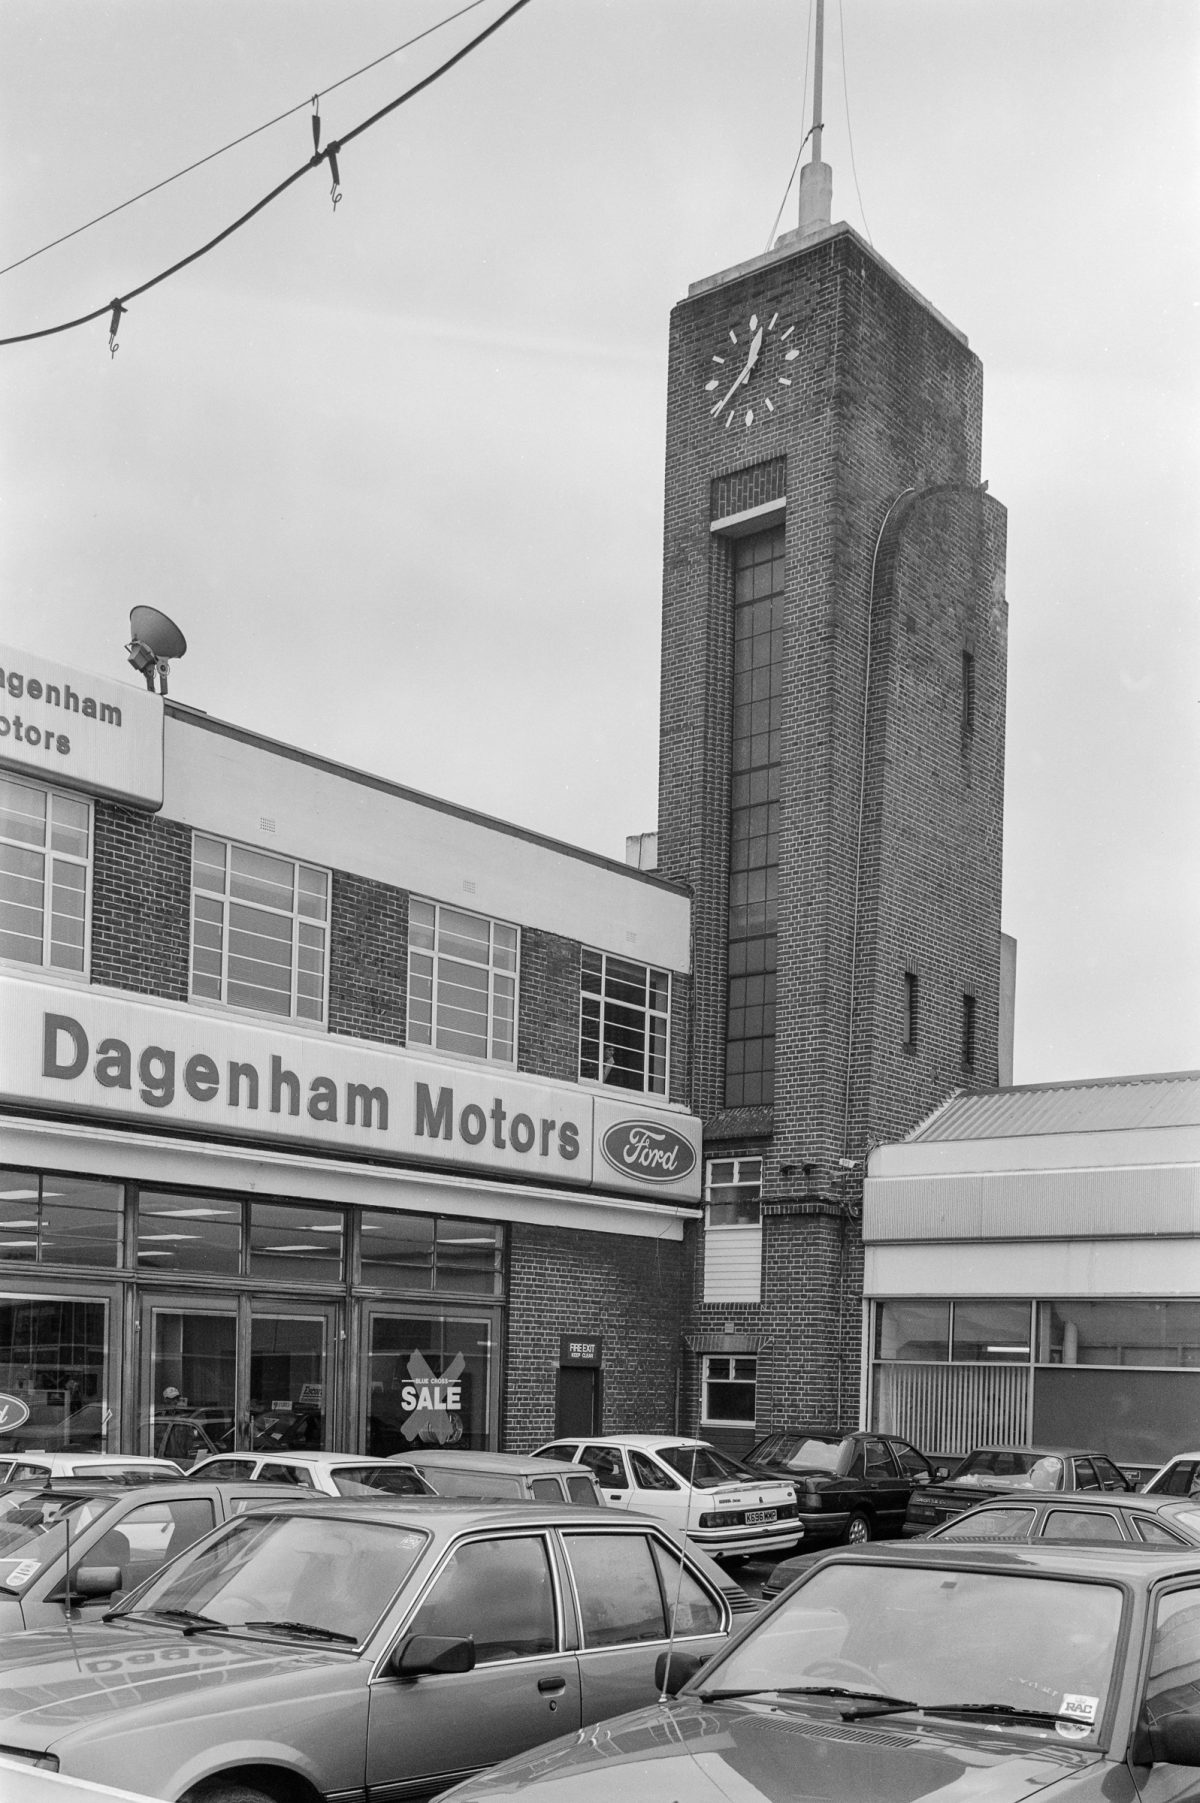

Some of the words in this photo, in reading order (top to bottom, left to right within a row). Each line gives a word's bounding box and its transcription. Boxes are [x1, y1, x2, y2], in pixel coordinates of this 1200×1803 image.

[41, 1011, 389, 1131] Dagenham
[414, 1081, 580, 1161] Motors
[623, 1127, 679, 1170] Ford
[569, 1343, 582, 1352] FIRE
[582, 1343, 595, 1353] EXIT
[401, 1386, 462, 1411] SALE
[1064, 1702, 1093, 1714] RAC
